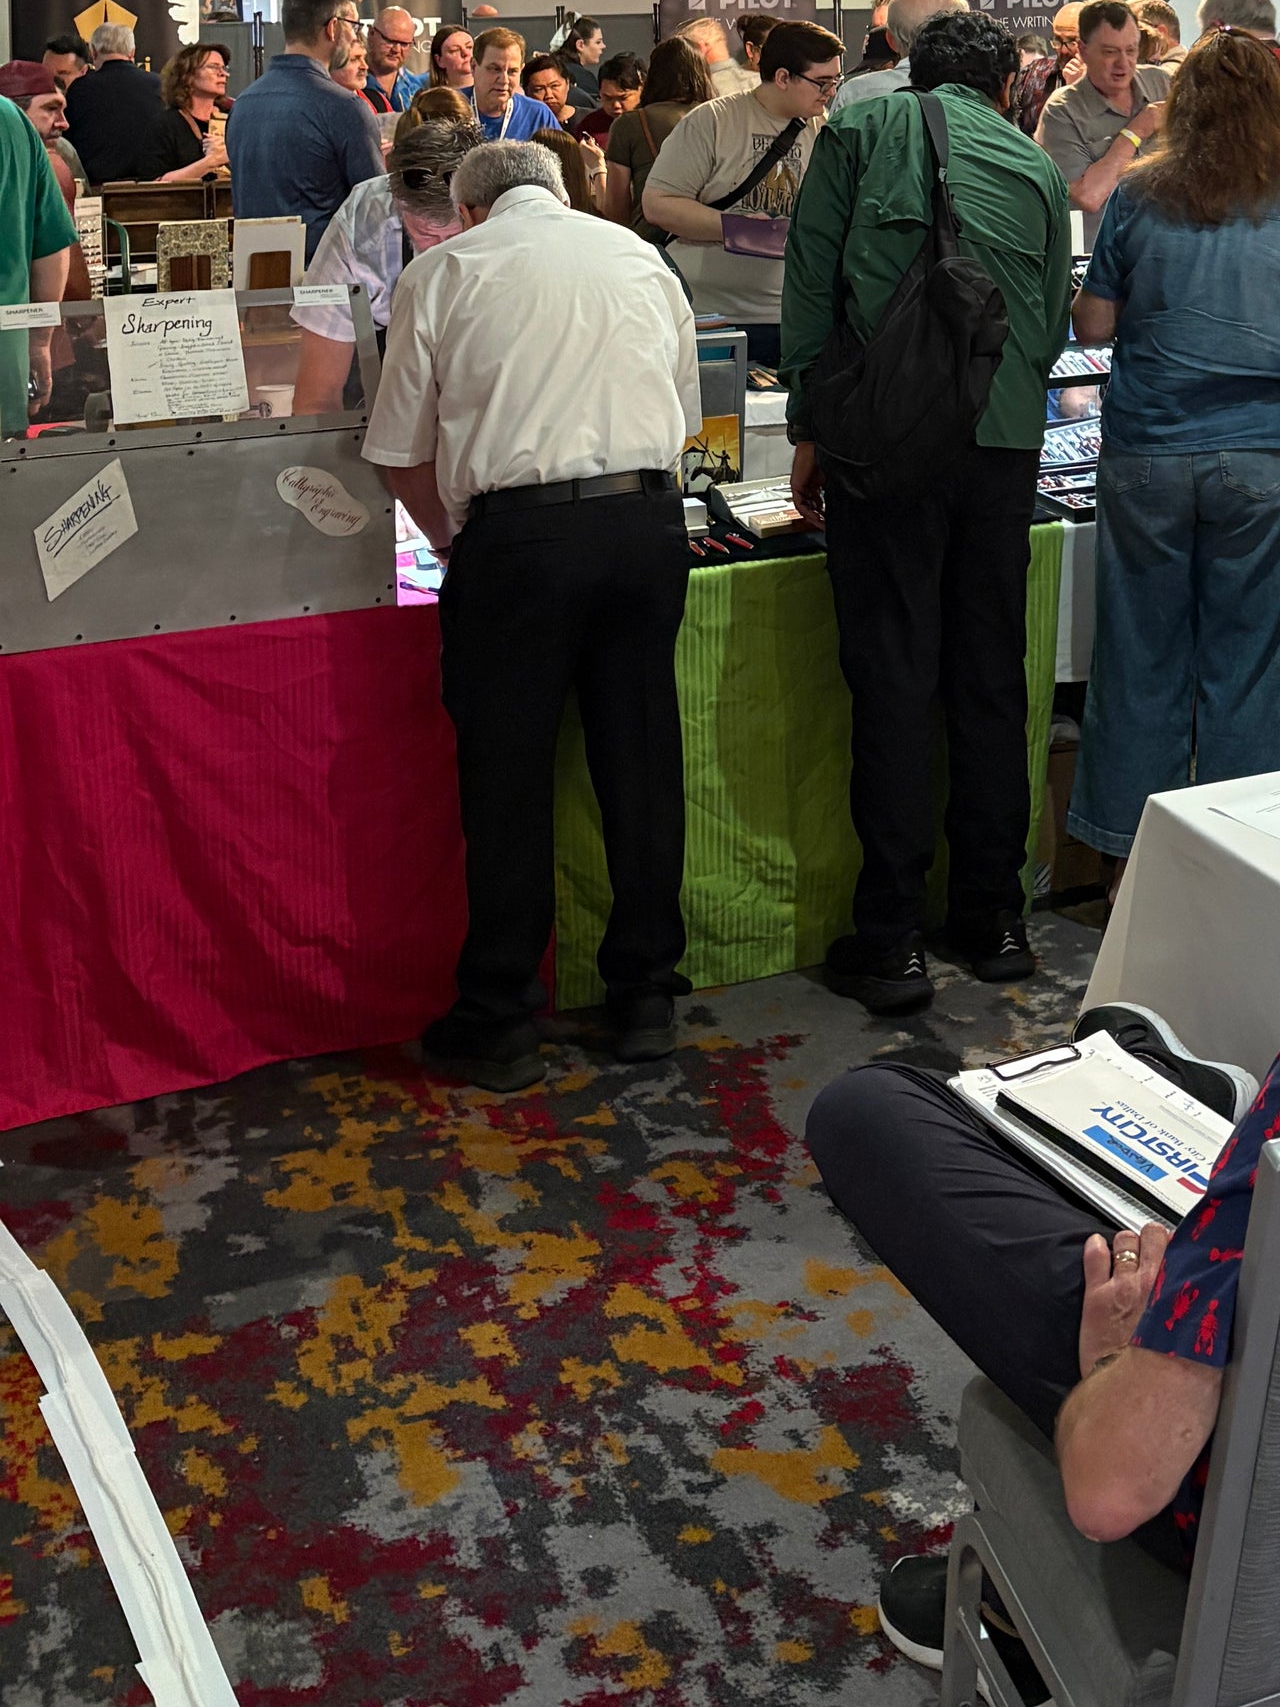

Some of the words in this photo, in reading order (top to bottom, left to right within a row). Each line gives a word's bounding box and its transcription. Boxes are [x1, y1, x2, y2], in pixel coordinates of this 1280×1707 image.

[1012, 15, 1055, 30] WRITIN
[141, 296, 197, 310] Expert
[121, 313, 213, 338] Sharpening
[44, 479, 112, 552] SHARPENING
[1115, 1100, 1145, 1122] Dallas
[1144, 1117, 1159, 1130] of
[1159, 1128, 1185, 1149] Bank
